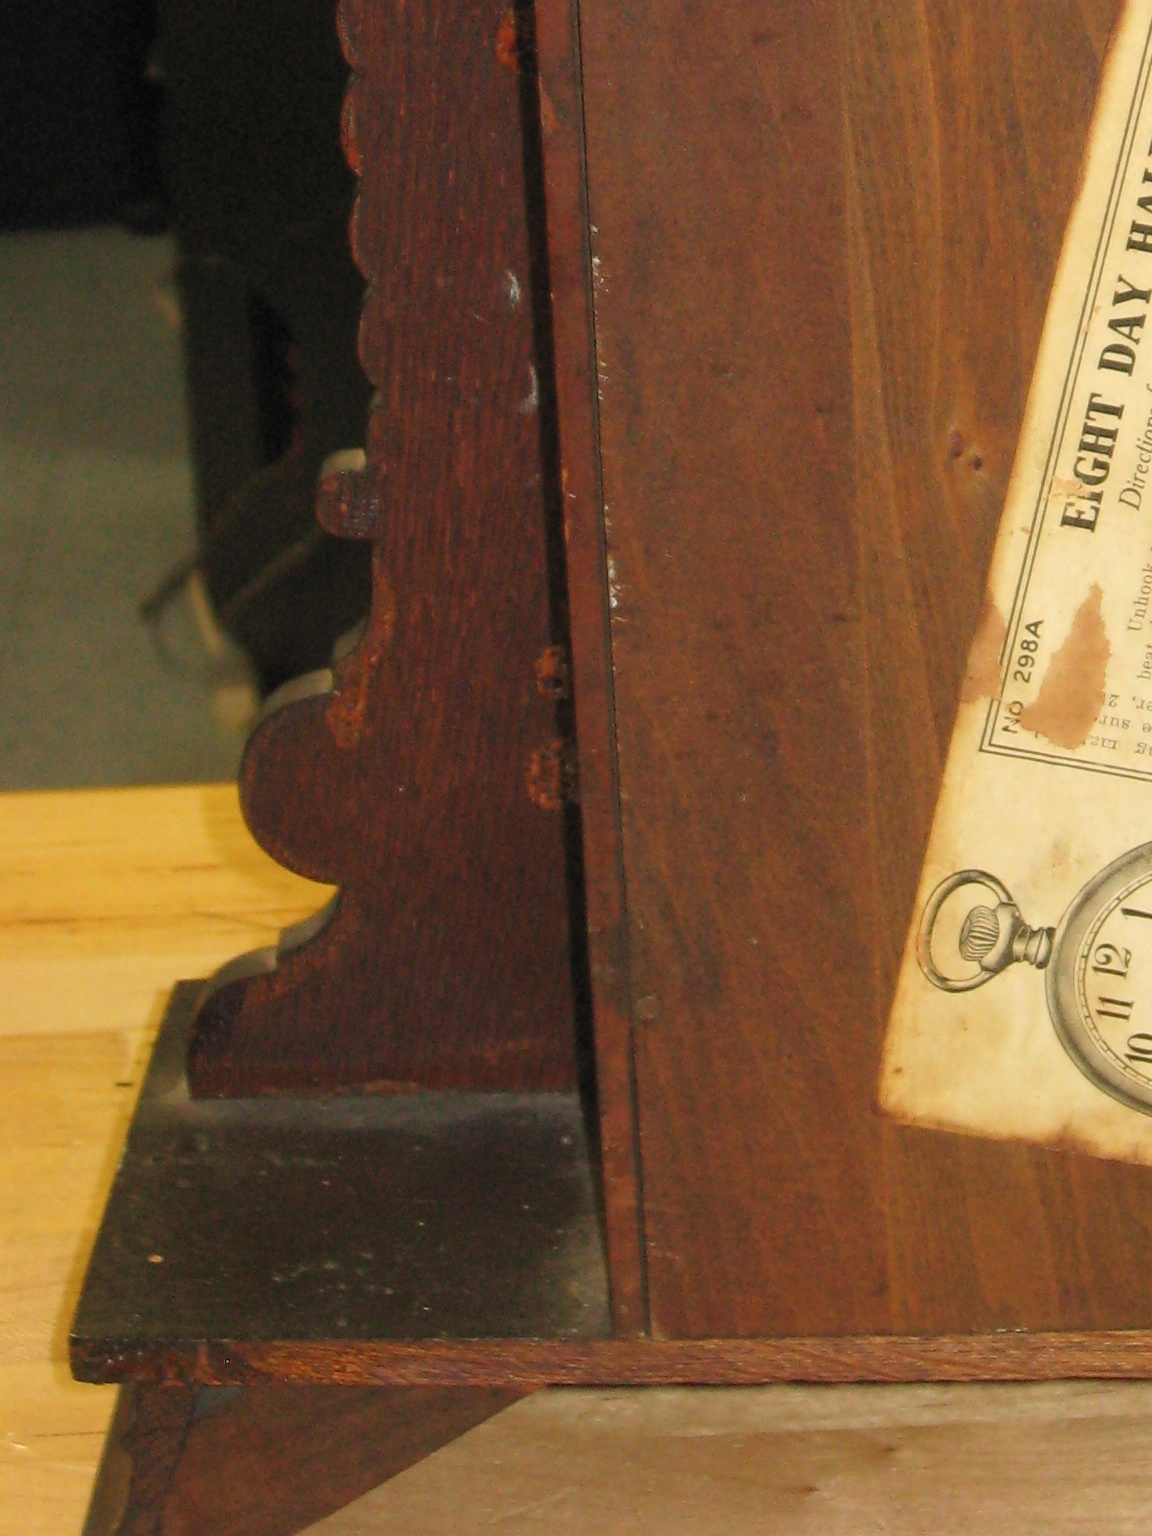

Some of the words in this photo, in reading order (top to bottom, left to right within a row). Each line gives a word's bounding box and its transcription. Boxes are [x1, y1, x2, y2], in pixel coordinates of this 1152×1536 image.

[1058, 391, 1125, 533] EIGHT
[1096, 273, 1152, 377] DAY
[1012, 619, 1044, 684] 298A
[1093, 714, 1131, 730] sur
[1090, 942, 1132, 979] 12
[1094, 995, 1135, 1022] 11
